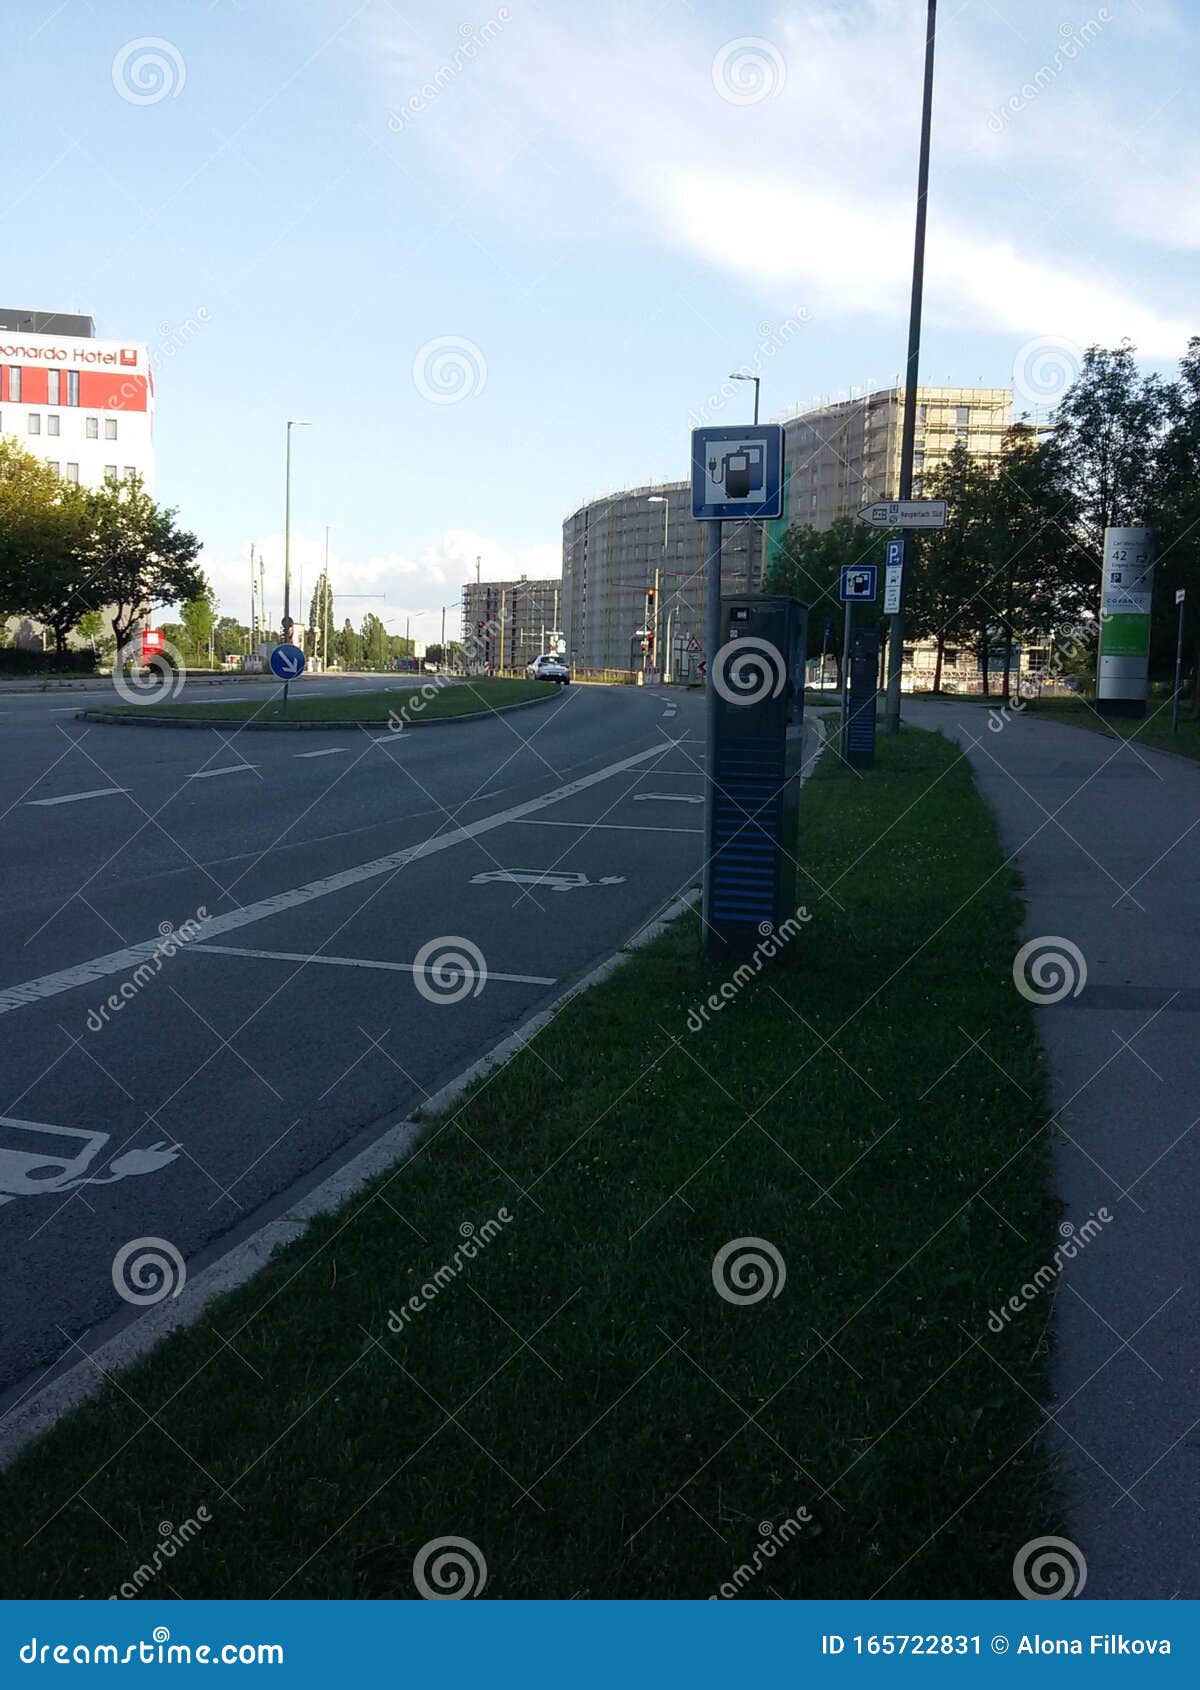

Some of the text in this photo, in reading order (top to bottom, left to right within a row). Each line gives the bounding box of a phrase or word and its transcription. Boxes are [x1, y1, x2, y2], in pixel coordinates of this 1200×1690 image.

[73, 348, 117, 365] Hotel
[889, 545, 899, 564] P
[1112, 550, 1127, 561] 42
